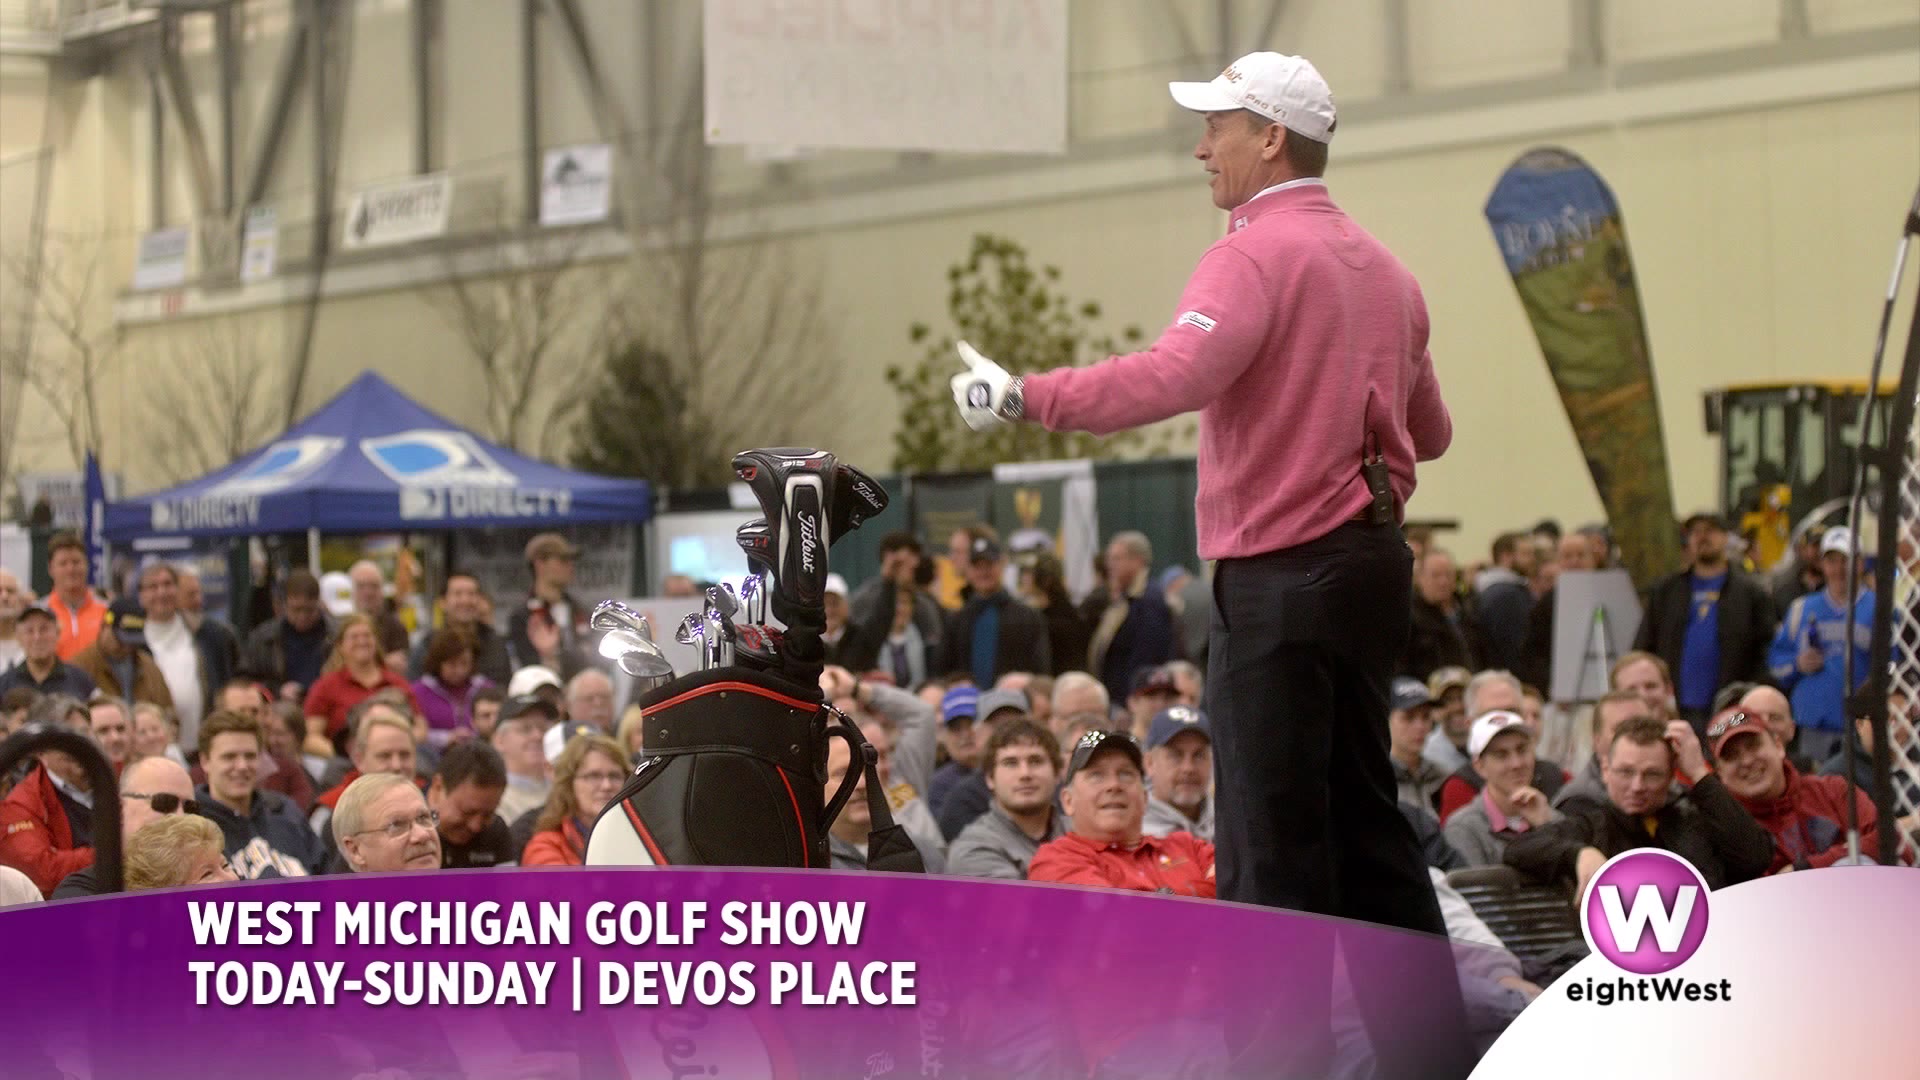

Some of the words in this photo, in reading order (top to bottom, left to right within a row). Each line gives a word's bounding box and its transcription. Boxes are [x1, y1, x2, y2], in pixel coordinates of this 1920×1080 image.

[182, 498, 260, 530] DIRECTV
[451, 484, 572, 518] DIRECTV
[797, 510, 818, 574] Titleist
